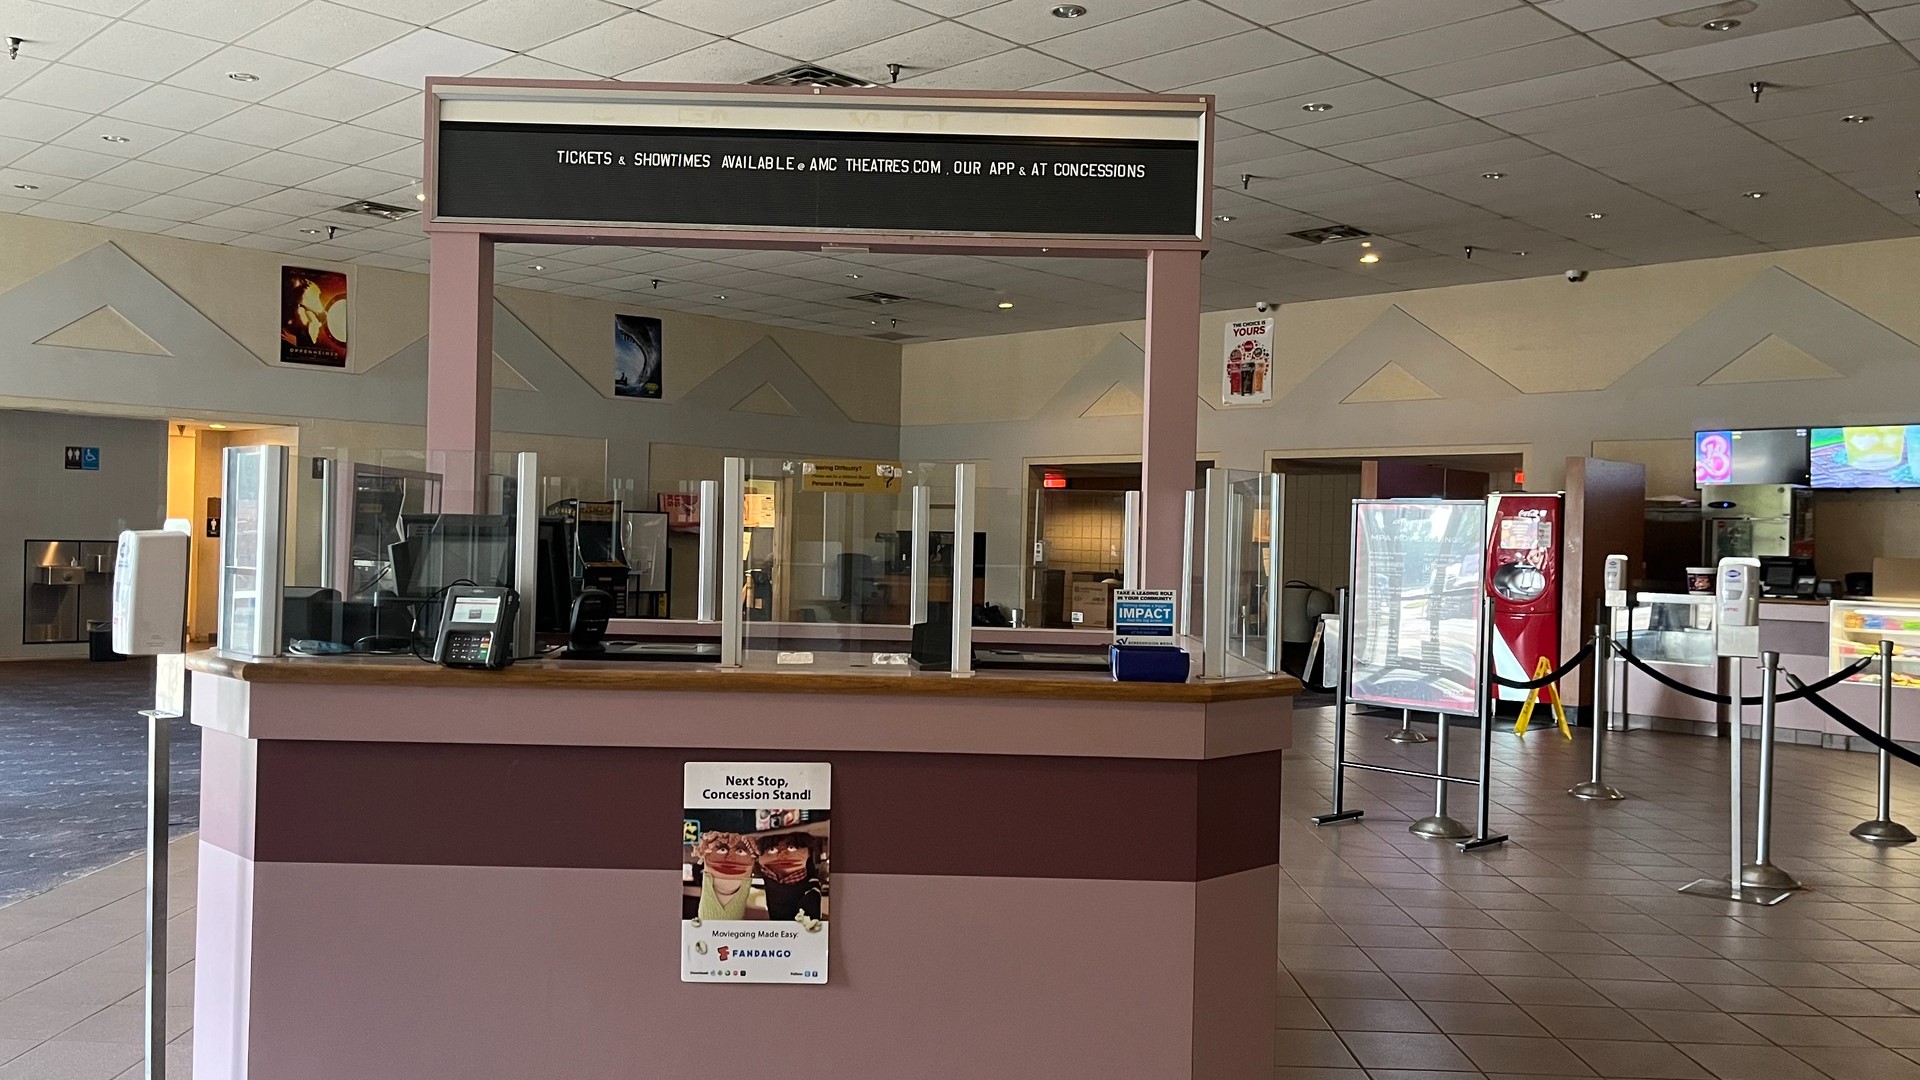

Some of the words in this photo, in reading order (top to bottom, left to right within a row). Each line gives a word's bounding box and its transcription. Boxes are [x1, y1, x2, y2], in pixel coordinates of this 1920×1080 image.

[556, 150, 613, 166] TICKETS
[618, 155, 626, 166] &
[633, 152, 711, 168] SHOWTIMES
[721, 154, 795, 171] AVAILABLE
[809, 157, 838, 172] AMC
[953, 160, 982, 175] OUR
[989, 160, 1016, 176] APP
[1018, 166, 1027, 176] &
[1030, 162, 1048, 176] AT
[1053, 162, 1146, 178] CONCESSIONS
[1233, 326, 1265, 337] YOURS
[290, 348, 338, 356] OPPENHEIMER
[1394, 534, 1422, 542] MOVE
[1119, 607, 1171, 619] IMPACT
[725, 775, 755, 786] Next
[757, 775, 789, 788] Stop,
[702, 789, 770, 800] Concession
[772, 789, 811, 801] Stand!
[711, 930, 756, 939] Moviegoing
[757, 930, 779, 938] Made
[732, 949, 791, 958] FANDANGO
